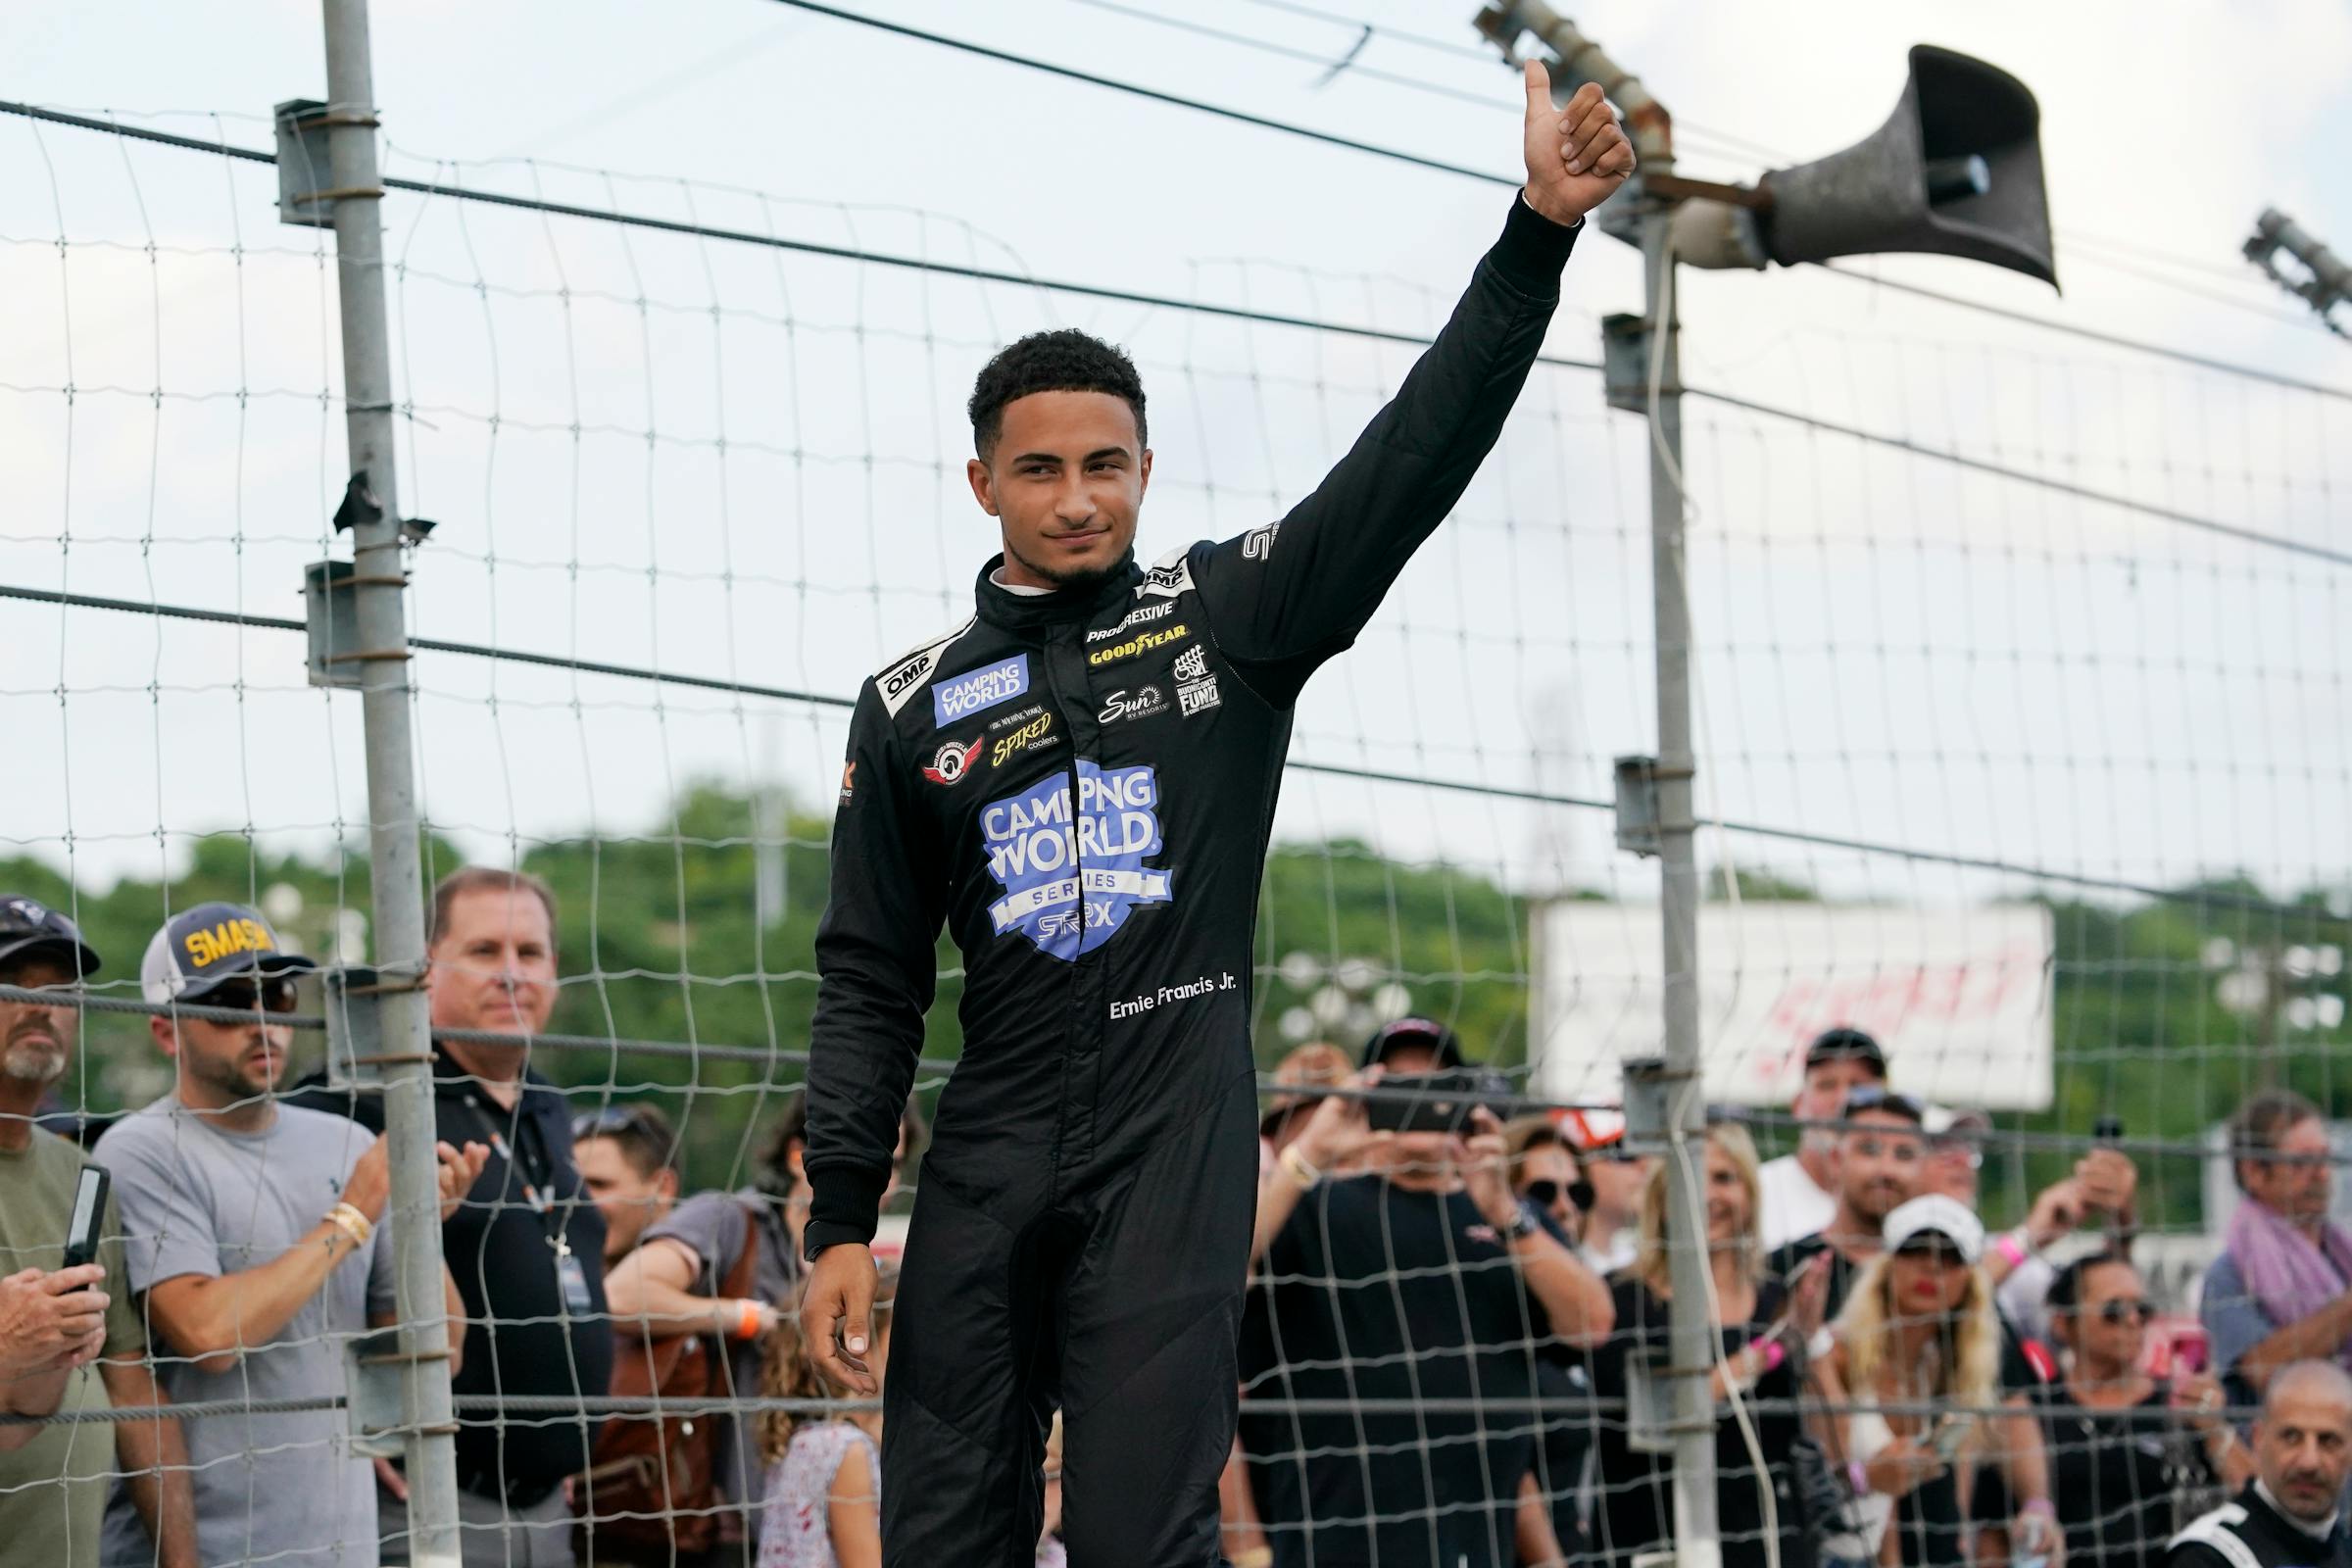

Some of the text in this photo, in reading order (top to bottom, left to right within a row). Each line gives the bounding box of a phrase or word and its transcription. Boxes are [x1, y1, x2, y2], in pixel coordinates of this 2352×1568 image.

[1086, 601, 1174, 643] PROGRESSIVE
[1090, 624, 1187, 664] GOODYEAR
[887, 657, 929, 694] OMP
[941, 663, 1019, 704] CAMPING
[943, 678, 1021, 716] WORLD
[1098, 690, 1152, 723] Sun
[1179, 685, 1218, 712] FUND
[992, 712, 1052, 766] SPIKED
[1028, 735, 1058, 750] coolers
[984, 772, 1152, 841] CAMPING
[989, 811, 1154, 878] WORLD
[1032, 873, 1115, 905] SERIES
[1109, 971, 1237, 1019] Ernie Francis Jr.
